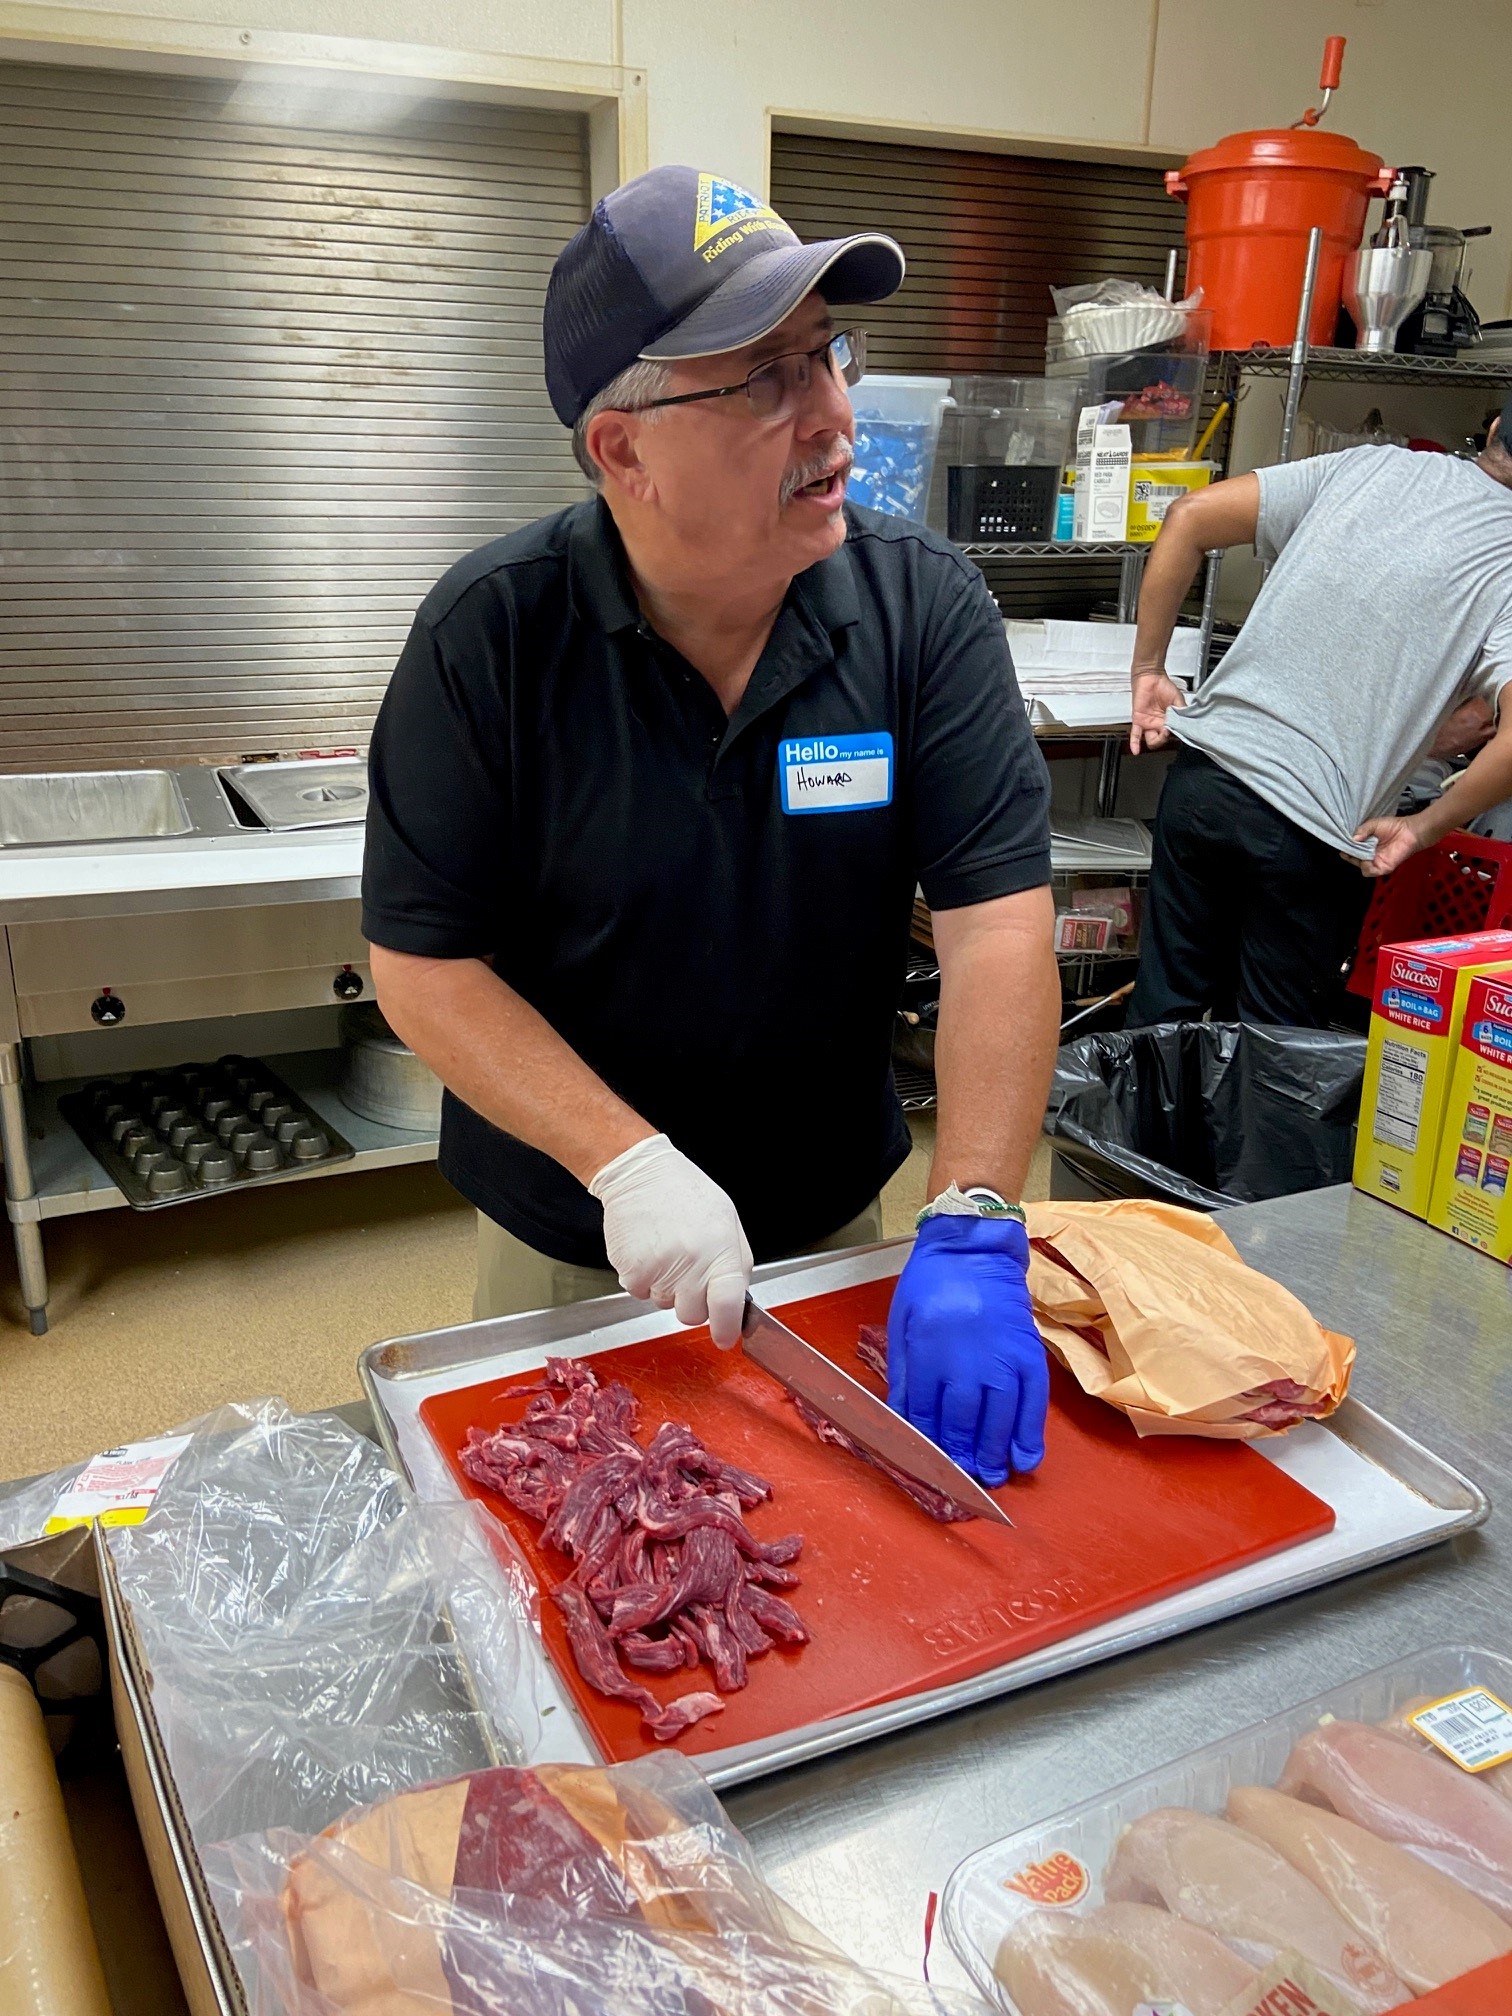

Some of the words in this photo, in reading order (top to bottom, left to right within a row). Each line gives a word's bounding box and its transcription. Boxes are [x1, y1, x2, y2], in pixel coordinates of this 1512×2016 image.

[699, 181, 710, 222] PATRIOT
[702, 231, 744, 263] Riding
[785, 741, 839, 763] Hello
[840, 751, 852, 759] my
[854, 749, 875, 757] name
[877, 748, 884, 756] is
[1392, 962, 1439, 988] Success
[1391, 991, 1397, 999] 6
[1401, 999, 1417, 1011] BOIL
[1423, 1006, 1439, 1017] BAG
[1388, 1009, 1412, 1024] WHITE
[1412, 1017, 1431, 1030] RICE
[1483, 1025, 1489, 1033] 6
[1384, 1039, 1409, 1051] Nutrition
[1410, 1048, 1426, 1058] Facts
[1480, 1044, 1506, 1062] WHITE
[1381, 1063, 1403, 1075] Calories
[1410, 1071, 1424, 1082] 180
[1003, 1851, 1072, 1895] Value
[1043, 1871, 1082, 1903] Pack
